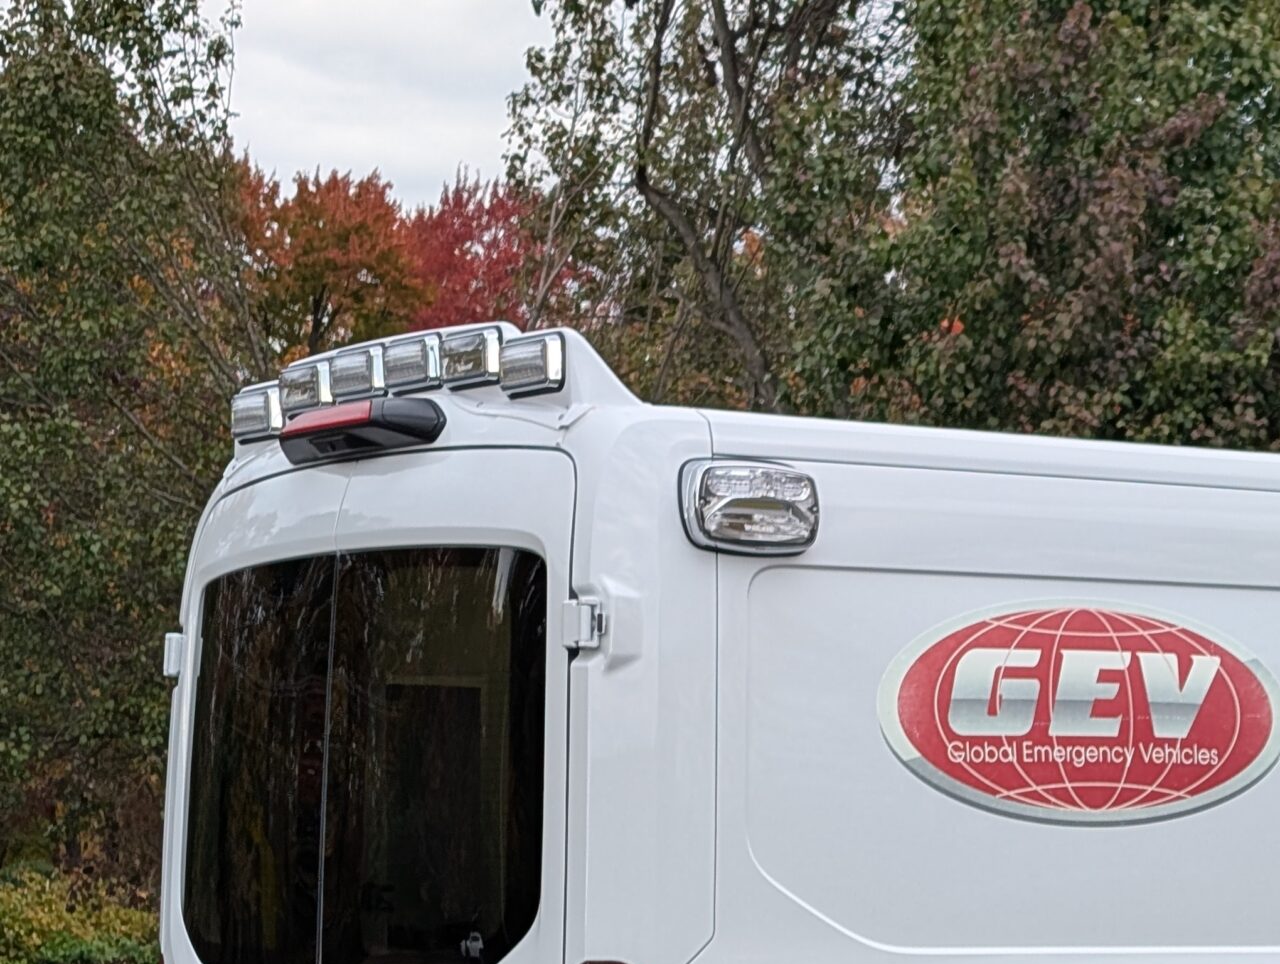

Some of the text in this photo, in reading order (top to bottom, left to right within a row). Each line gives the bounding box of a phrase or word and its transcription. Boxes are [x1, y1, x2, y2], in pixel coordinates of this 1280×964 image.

[947, 647, 1222, 738] GEV
[947, 740, 1220, 768] Global Emergency Vehicles
